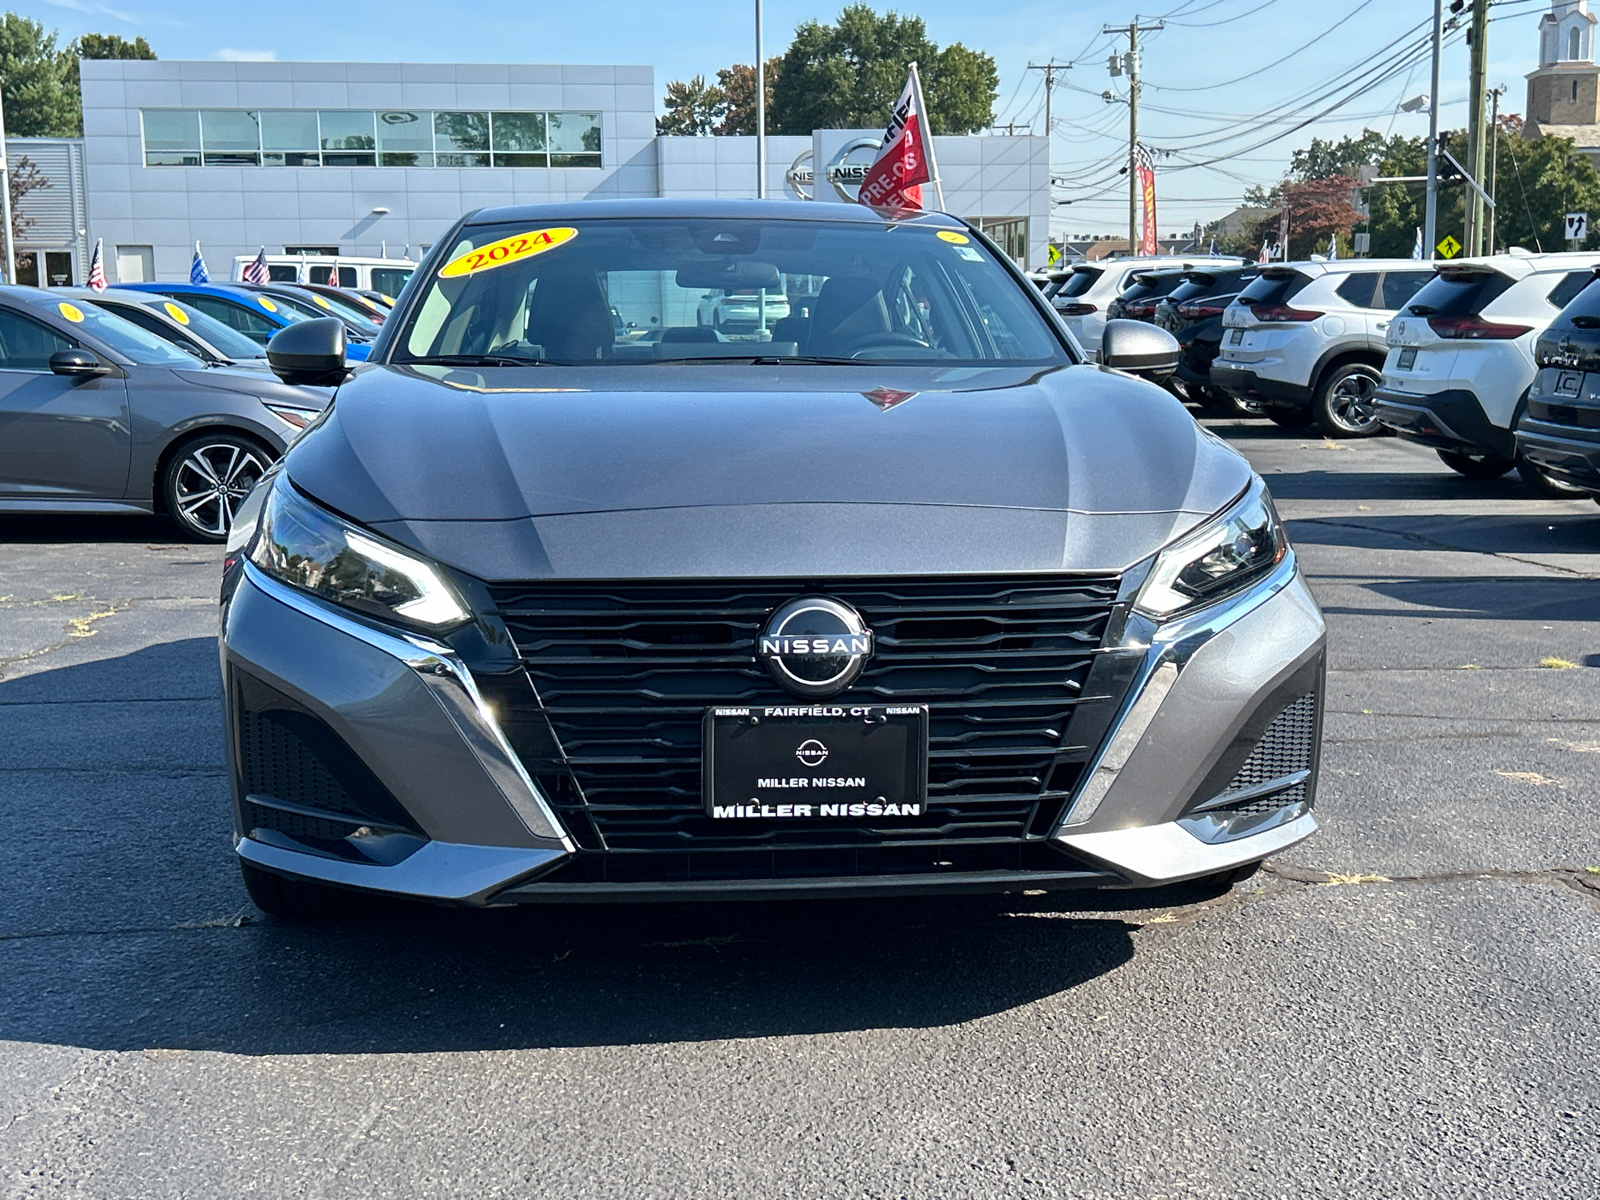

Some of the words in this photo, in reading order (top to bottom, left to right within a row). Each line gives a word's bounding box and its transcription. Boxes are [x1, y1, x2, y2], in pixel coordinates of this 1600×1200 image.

[466, 232, 555, 270] 2024
[762, 638, 868, 654] NISSAN
[715, 708, 750, 717] NISSAN
[764, 707, 847, 717] FAIRFIELD,
[850, 706, 872, 716] CT
[886, 706, 920, 715] NISSAN
[757, 778, 808, 788] MILLER
[812, 777, 866, 788] NISSAN
[713, 803, 812, 819] MILLER
[819, 803, 920, 817] NISSAN
